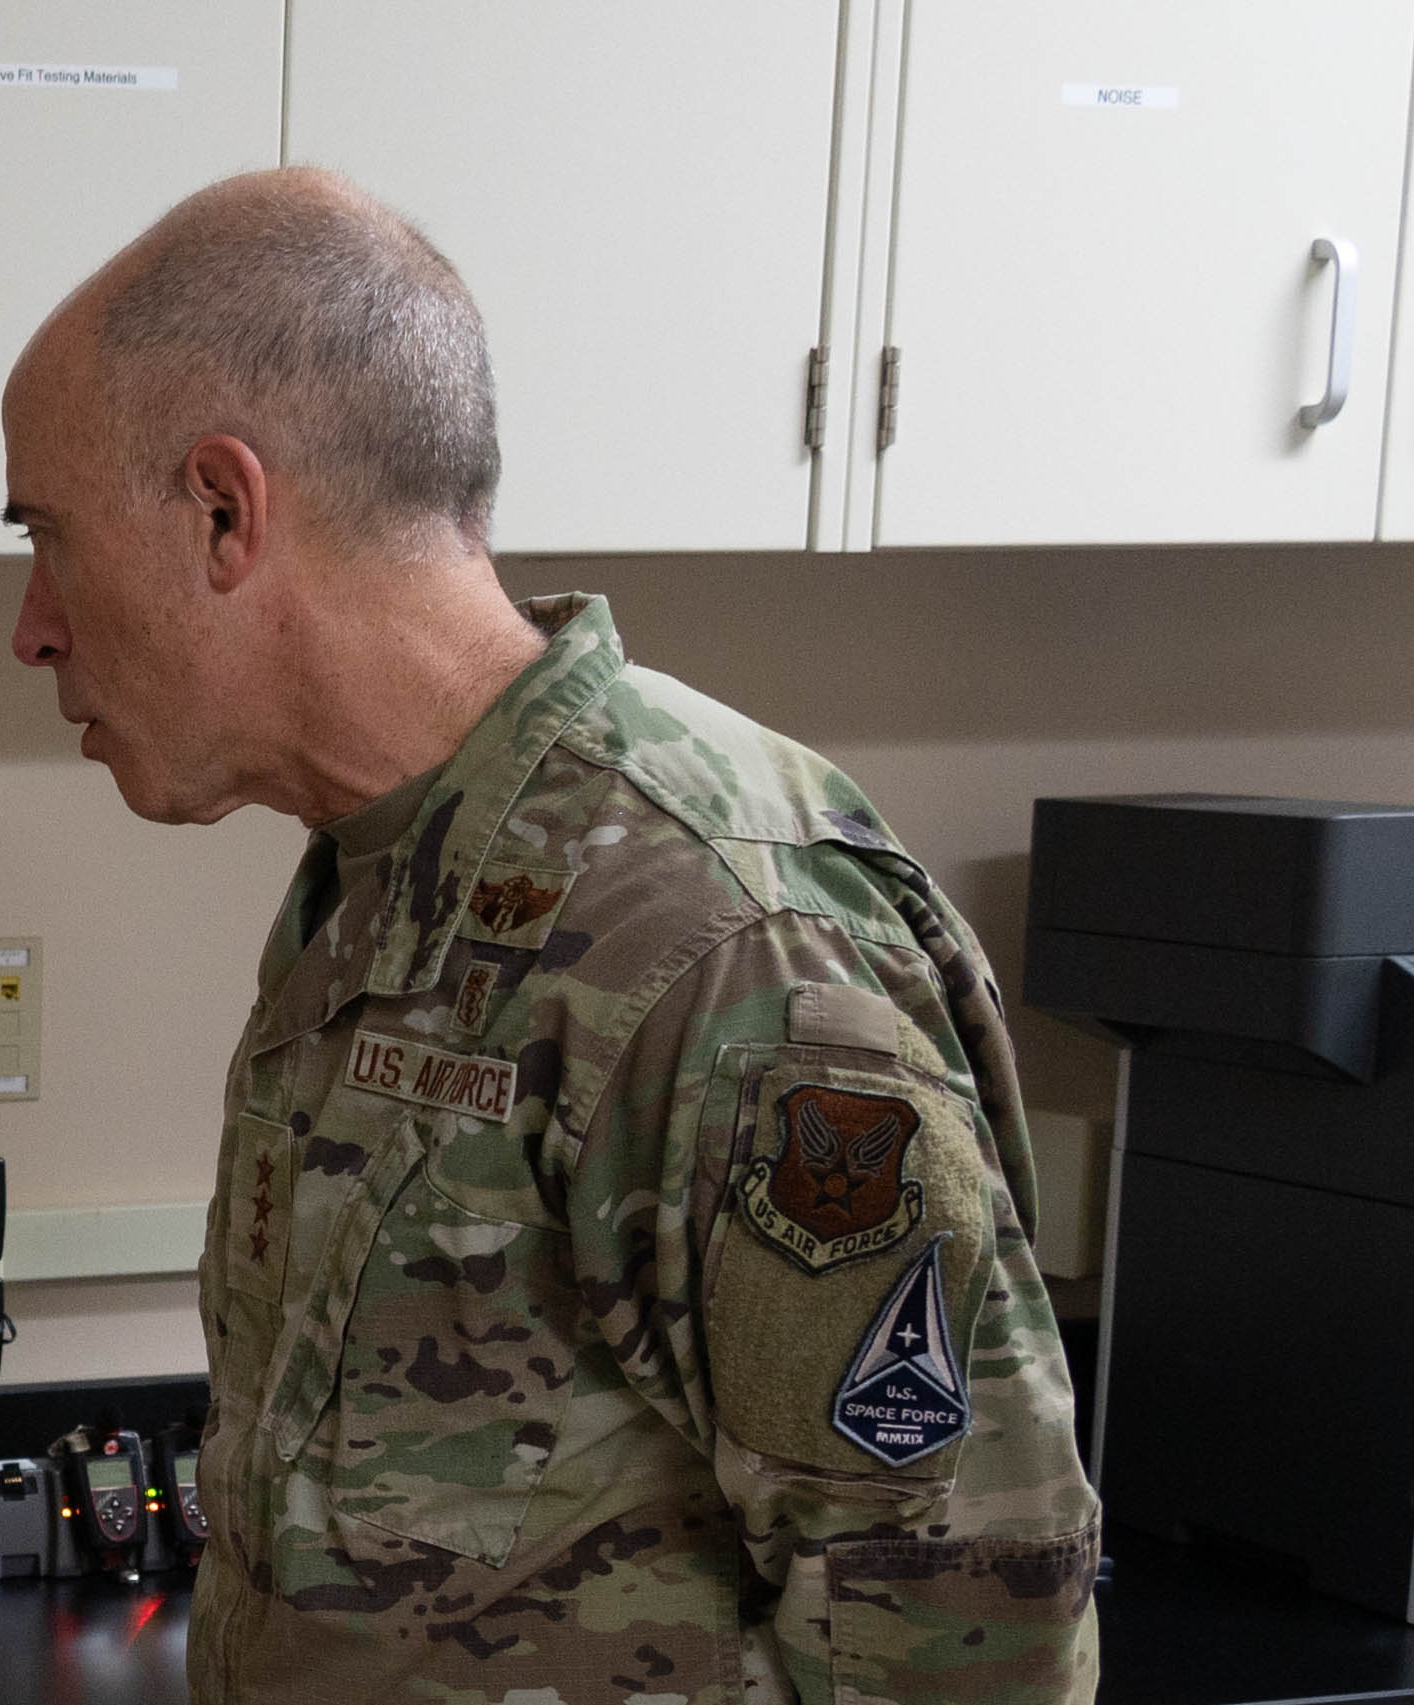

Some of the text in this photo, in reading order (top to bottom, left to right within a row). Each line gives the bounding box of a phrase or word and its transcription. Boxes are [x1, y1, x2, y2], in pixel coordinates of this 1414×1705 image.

[17, 68, 33, 81] Fit
[36, 69, 80, 85] Testing
[83, 70, 138, 85] Materials
[1097, 88, 1143, 105] NOISE
[353, 1040, 404, 1089] U.S.
[755, 1198, 899, 1259] US AIR FORCE
[886, 1385, 917, 1400] U.S.
[845, 1403, 958, 1424] SPACE FORCE
[875, 1431, 924, 1445] MMXIX
